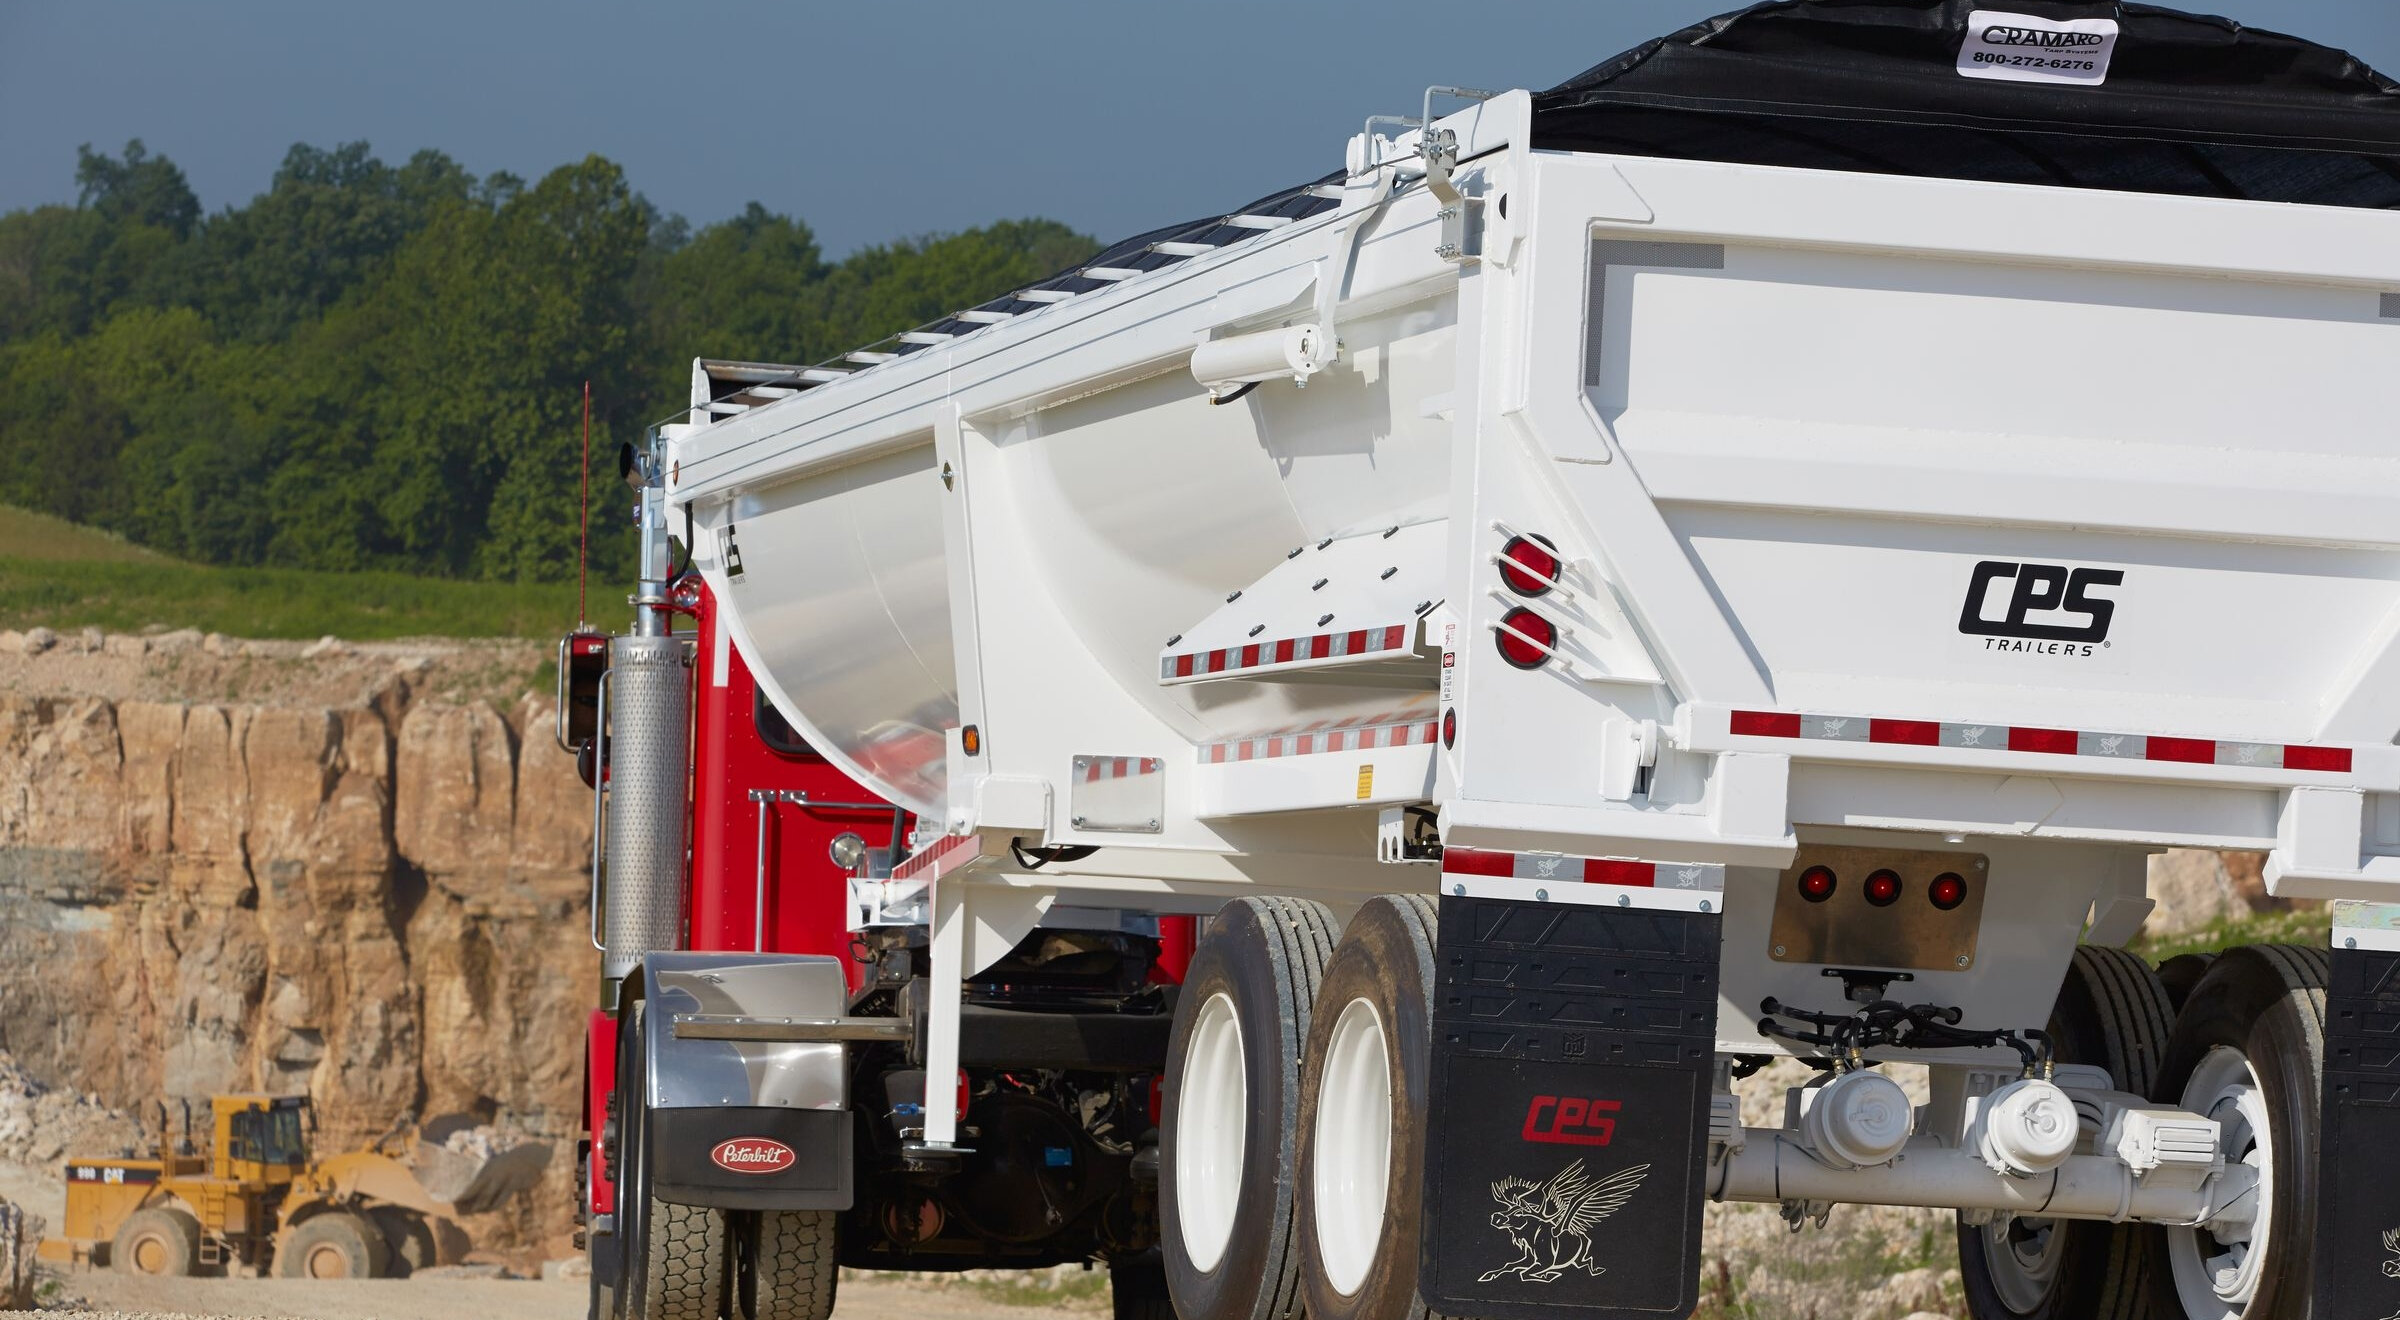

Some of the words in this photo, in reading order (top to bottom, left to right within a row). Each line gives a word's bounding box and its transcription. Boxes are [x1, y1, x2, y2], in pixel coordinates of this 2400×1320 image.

[1981, 25, 2103, 47] CRAMARO
[1973, 52, 2094, 71] 800-272-6276
[1958, 560, 2125, 644] CPS
[1985, 638, 2093, 657] TRAILERS
[1521, 1095, 1622, 1146] CPS
[723, 1144, 787, 1164] Peterbilt
[103, 1167, 125, 1184] CAT
